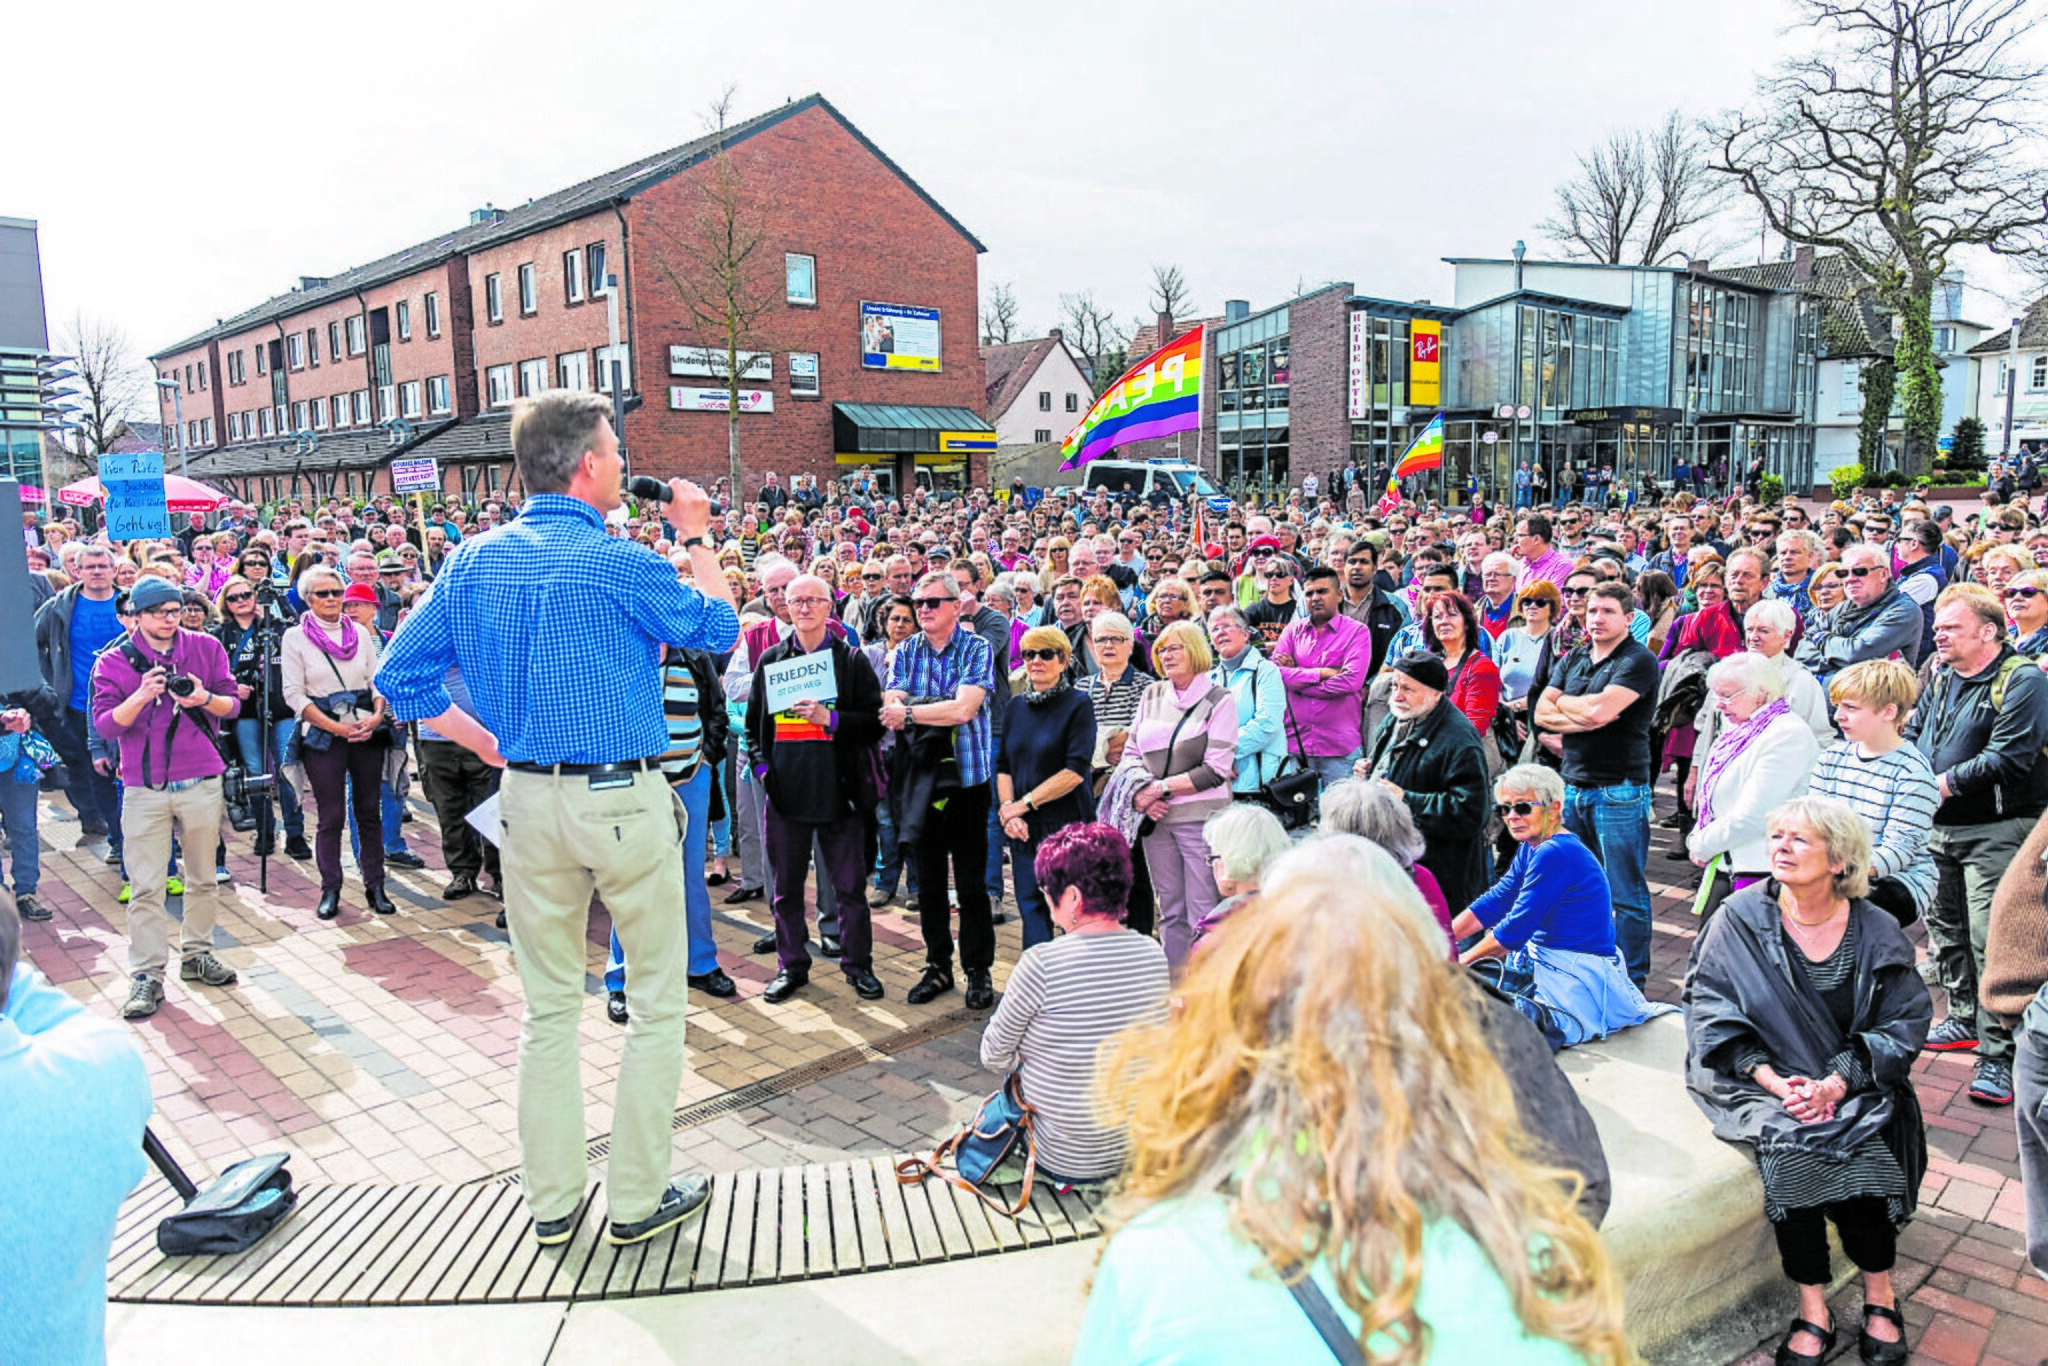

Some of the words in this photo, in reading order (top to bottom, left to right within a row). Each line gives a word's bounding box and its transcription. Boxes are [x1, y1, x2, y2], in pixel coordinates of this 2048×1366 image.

[1353, 313, 1361, 362] HEIDE
[672, 355, 736, 369] Lindenpassag
[1351, 368, 1361, 416] OPTIK
[115, 515, 144, 533] Geht
[769, 661, 828, 686] FRIEDEN
[777, 687, 786, 696] IST
[787, 684, 802, 694] DER
[803, 679, 822, 689] WEG
